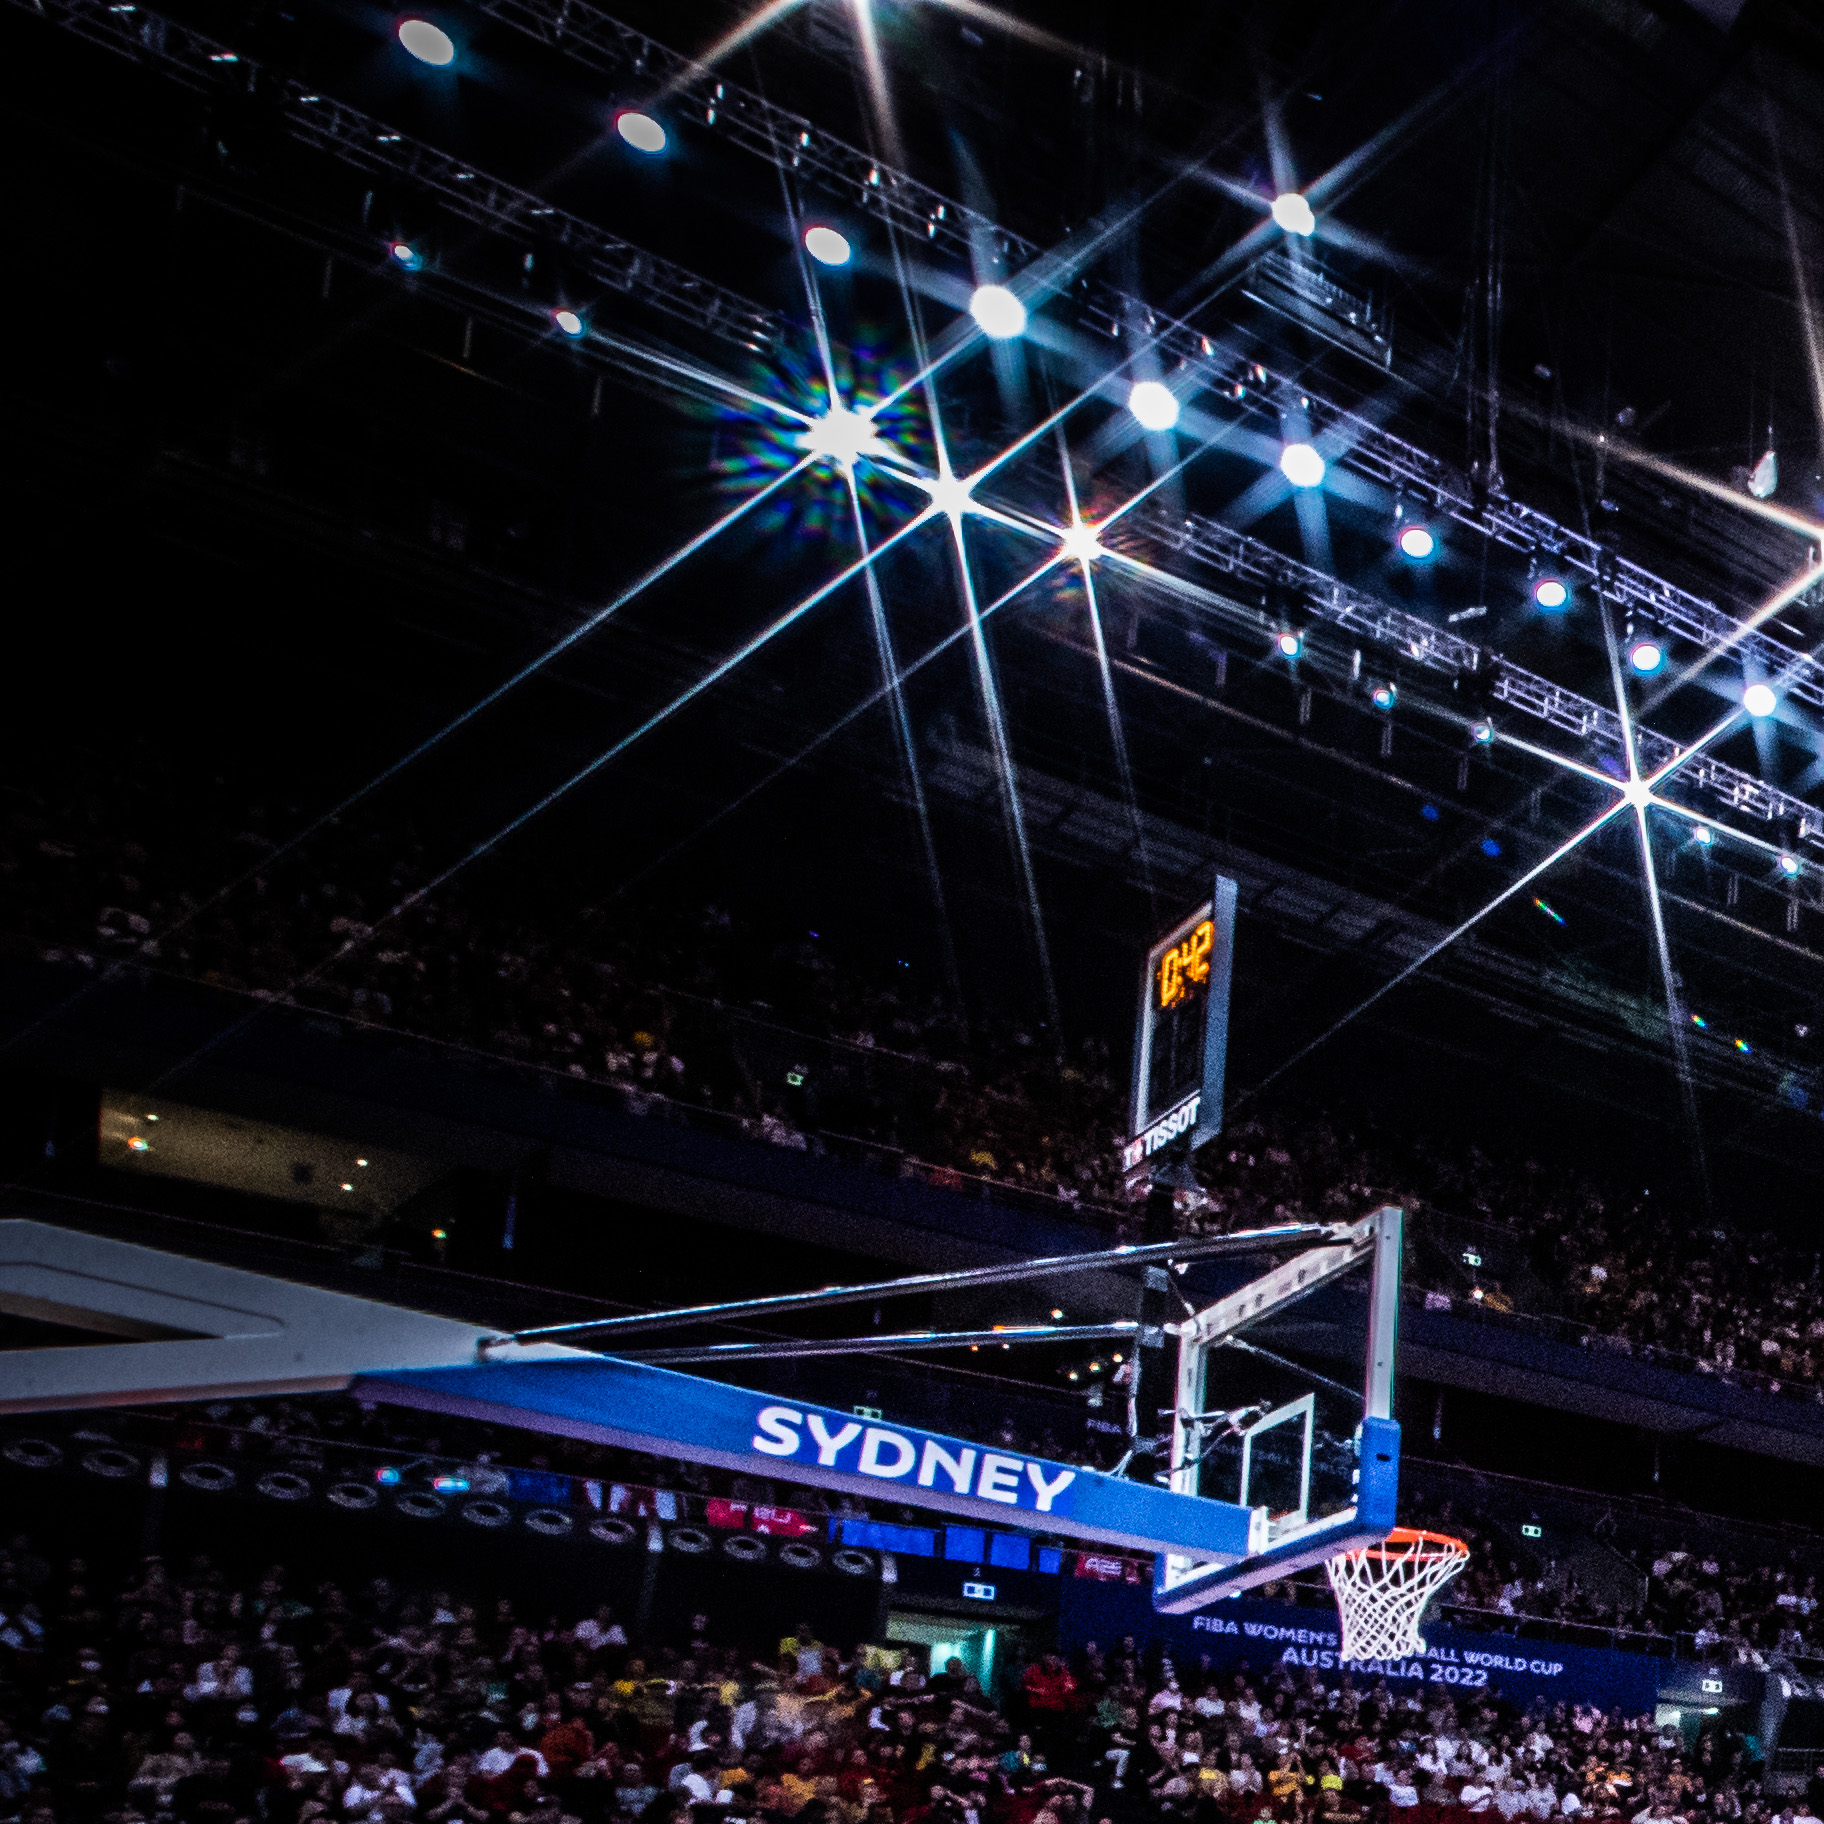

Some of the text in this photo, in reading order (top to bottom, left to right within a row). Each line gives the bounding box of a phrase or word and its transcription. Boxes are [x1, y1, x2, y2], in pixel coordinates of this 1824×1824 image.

[1145, 1096, 1201, 1156] TISSOT
[752, 1405, 1077, 1511] SYDNEY
[1429, 1664, 1488, 1687] 2022
